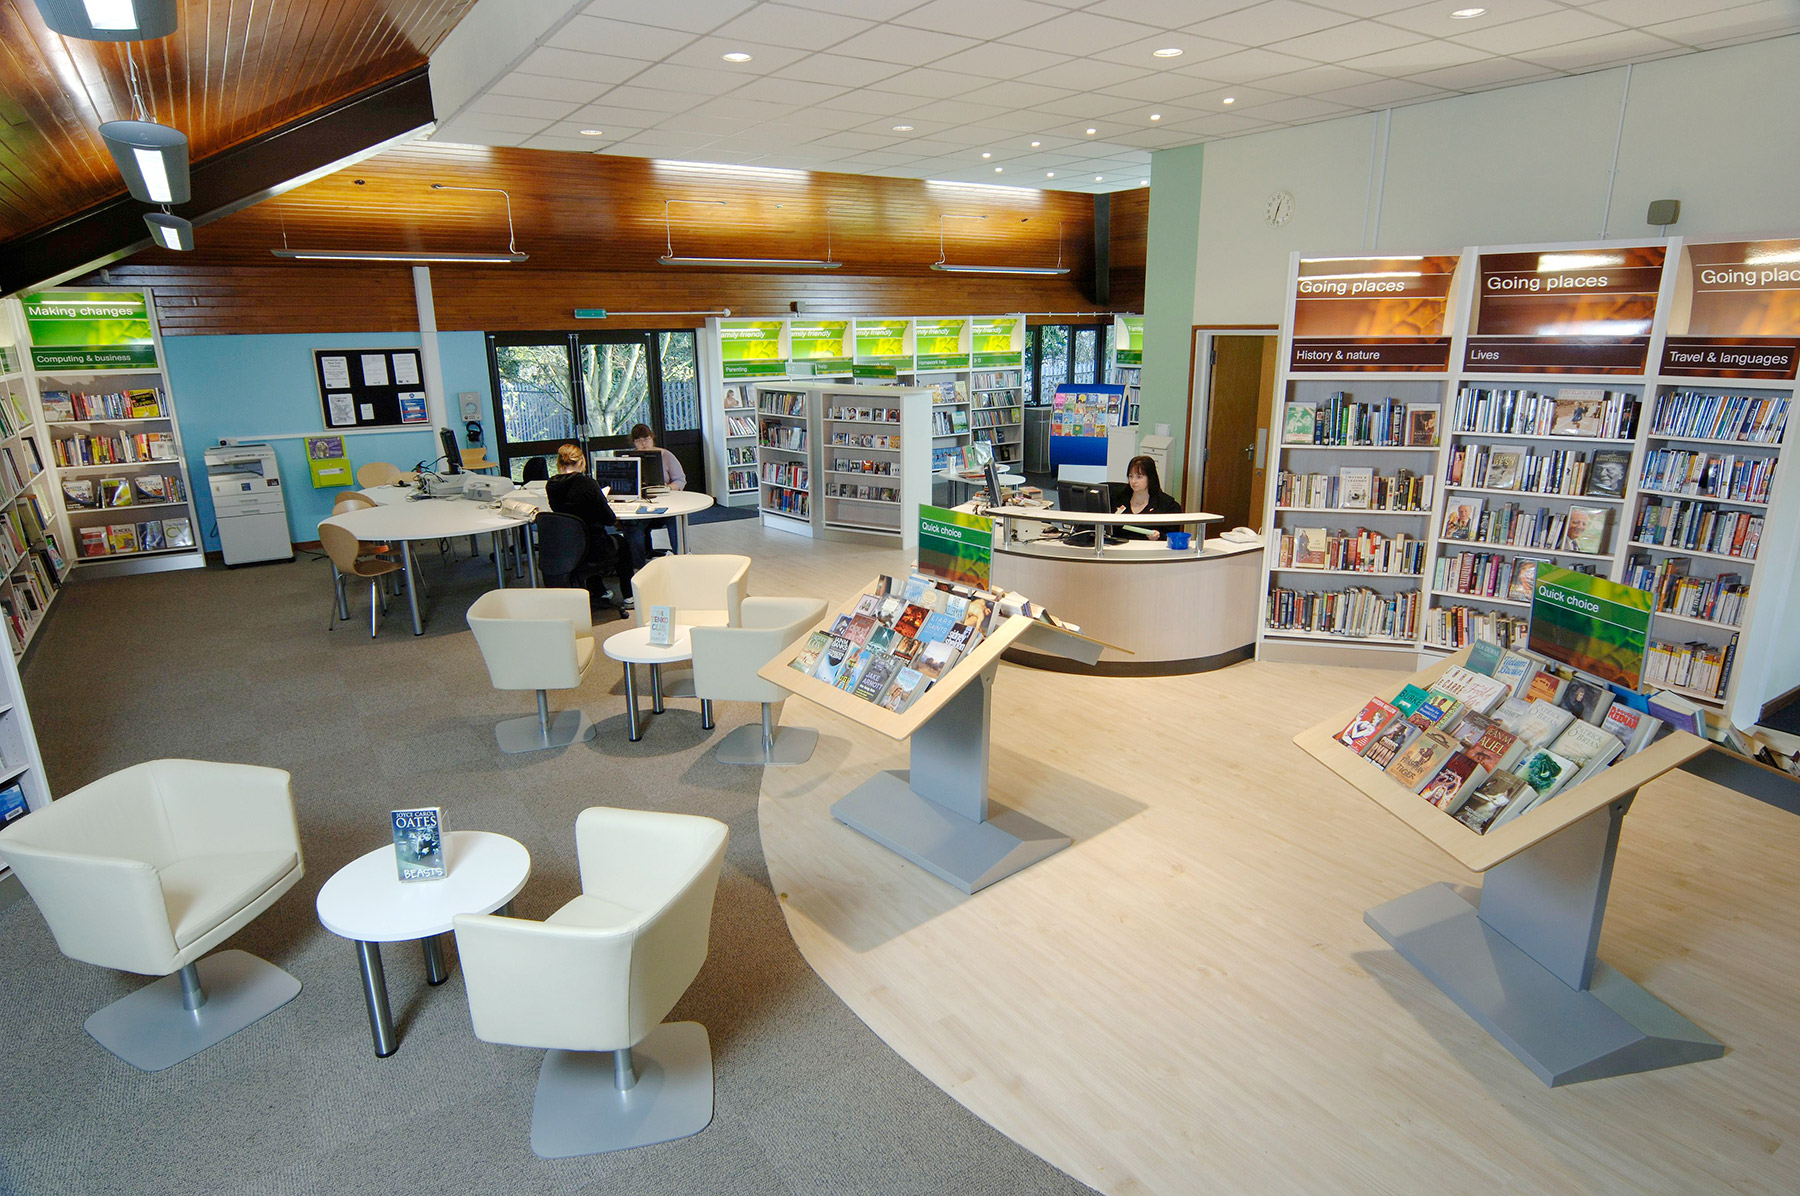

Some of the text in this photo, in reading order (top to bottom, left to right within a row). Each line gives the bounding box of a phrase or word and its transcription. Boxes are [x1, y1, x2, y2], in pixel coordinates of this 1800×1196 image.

[1488, 275, 1608, 291] Going places
[1701, 268, 1800, 286] Going plac
[1300, 280, 1405, 295] Going places
[28, 306, 134, 318] Making changes
[791, 330, 806, 338] amily
[36, 355, 84, 364] Computing
[94, 354, 132, 362] business
[1296, 350, 1380, 362] History & nature
[1470, 350, 1500, 360] Lives
[1670, 350, 1788, 366] Travel & languages
[922, 522, 962, 538] Quick choice
[1538, 585, 1599, 613] Quick choice
[931, 614, 953, 626] LIARS
[926, 624, 948, 634] SAINTS
[862, 678, 884, 690] ARNOTT
[866, 672, 881, 682] JAKE
[1399, 690, 1423, 706] BURKE
[1608, 706, 1640, 730] REEMAN
[1616, 708, 1640, 721] DOUGLAS
[1568, 728, 1599, 749] O'BRIAN
[1576, 723, 1603, 741] PATRICK
[1478, 736, 1505, 756] AUEL
[1366, 742, 1396, 766] RYAN
[1396, 763, 1416, 780] TIGER
[396, 816, 437, 828] OATES
[404, 868, 443, 879] BEASTS
